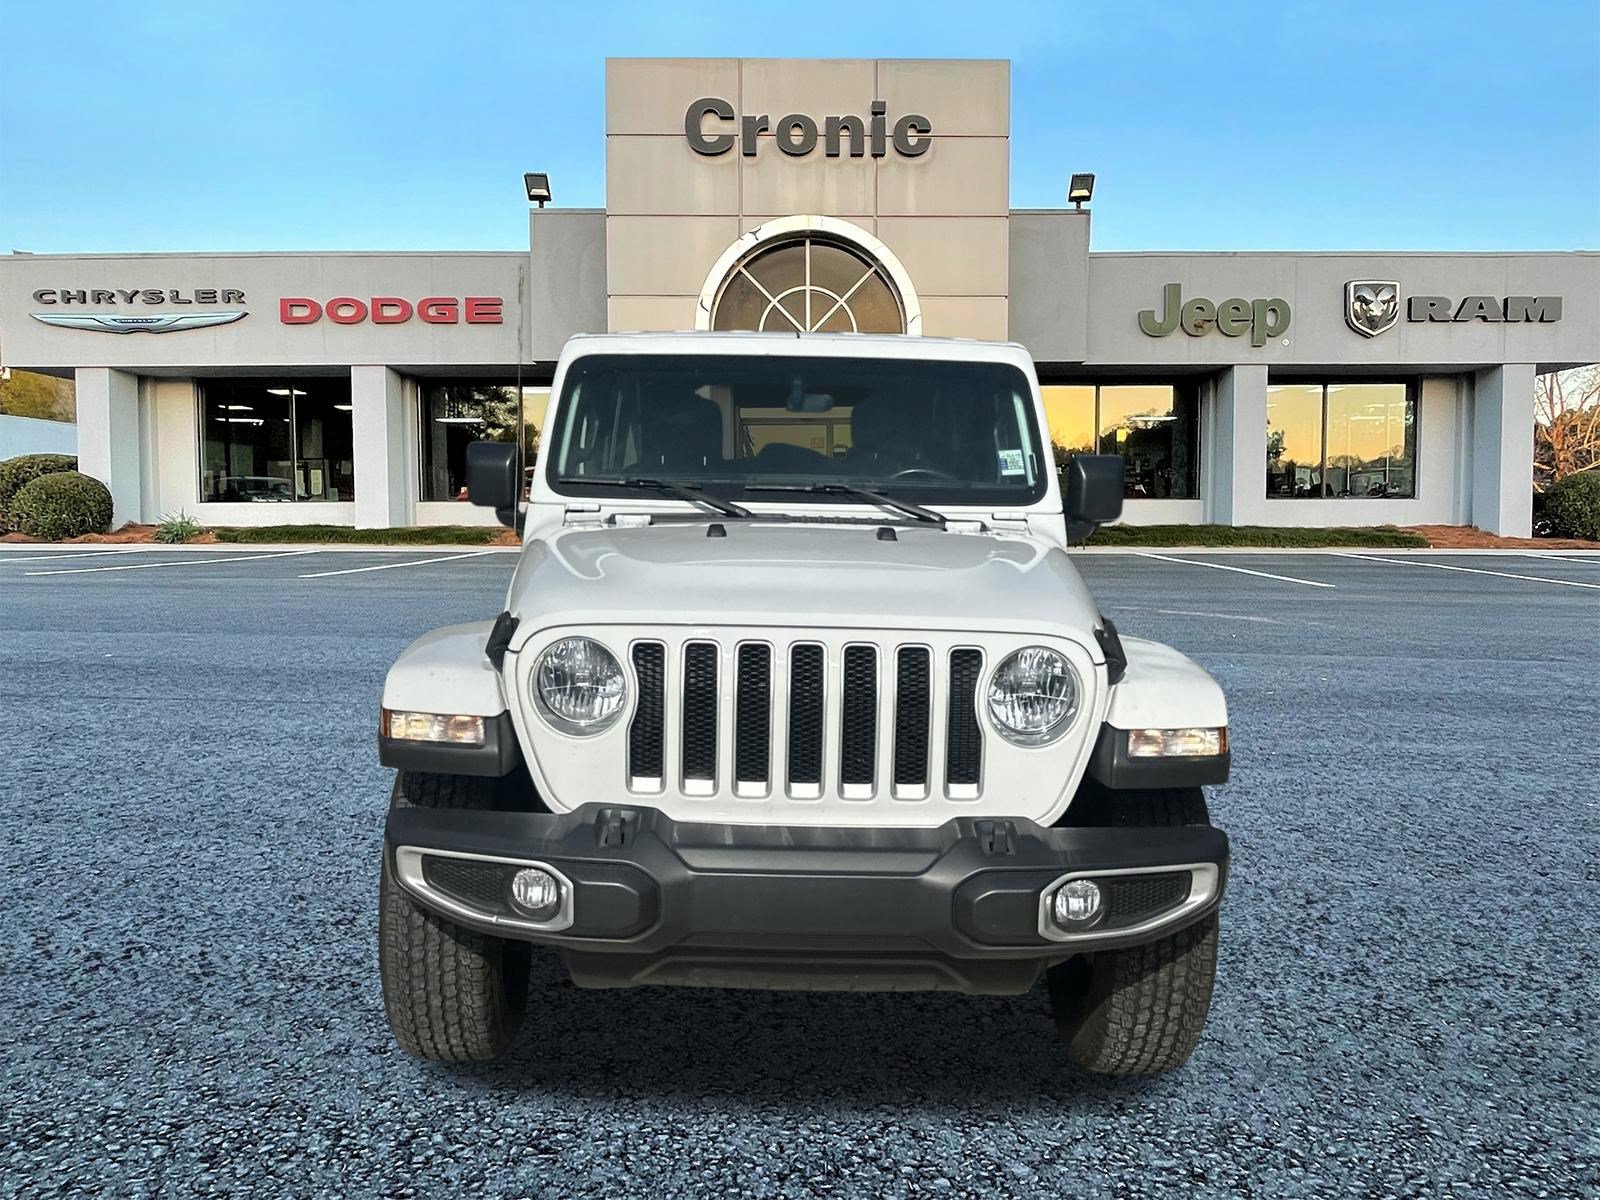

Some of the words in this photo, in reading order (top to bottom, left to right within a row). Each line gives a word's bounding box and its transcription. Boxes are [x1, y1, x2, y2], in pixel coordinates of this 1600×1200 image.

[685, 97, 932, 157] Cronic
[33, 288, 246, 304] CHRYSLER
[1408, 296, 1563, 322] RAM
[280, 297, 504, 325] DODGE
[1138, 283, 1291, 346] Jeep
